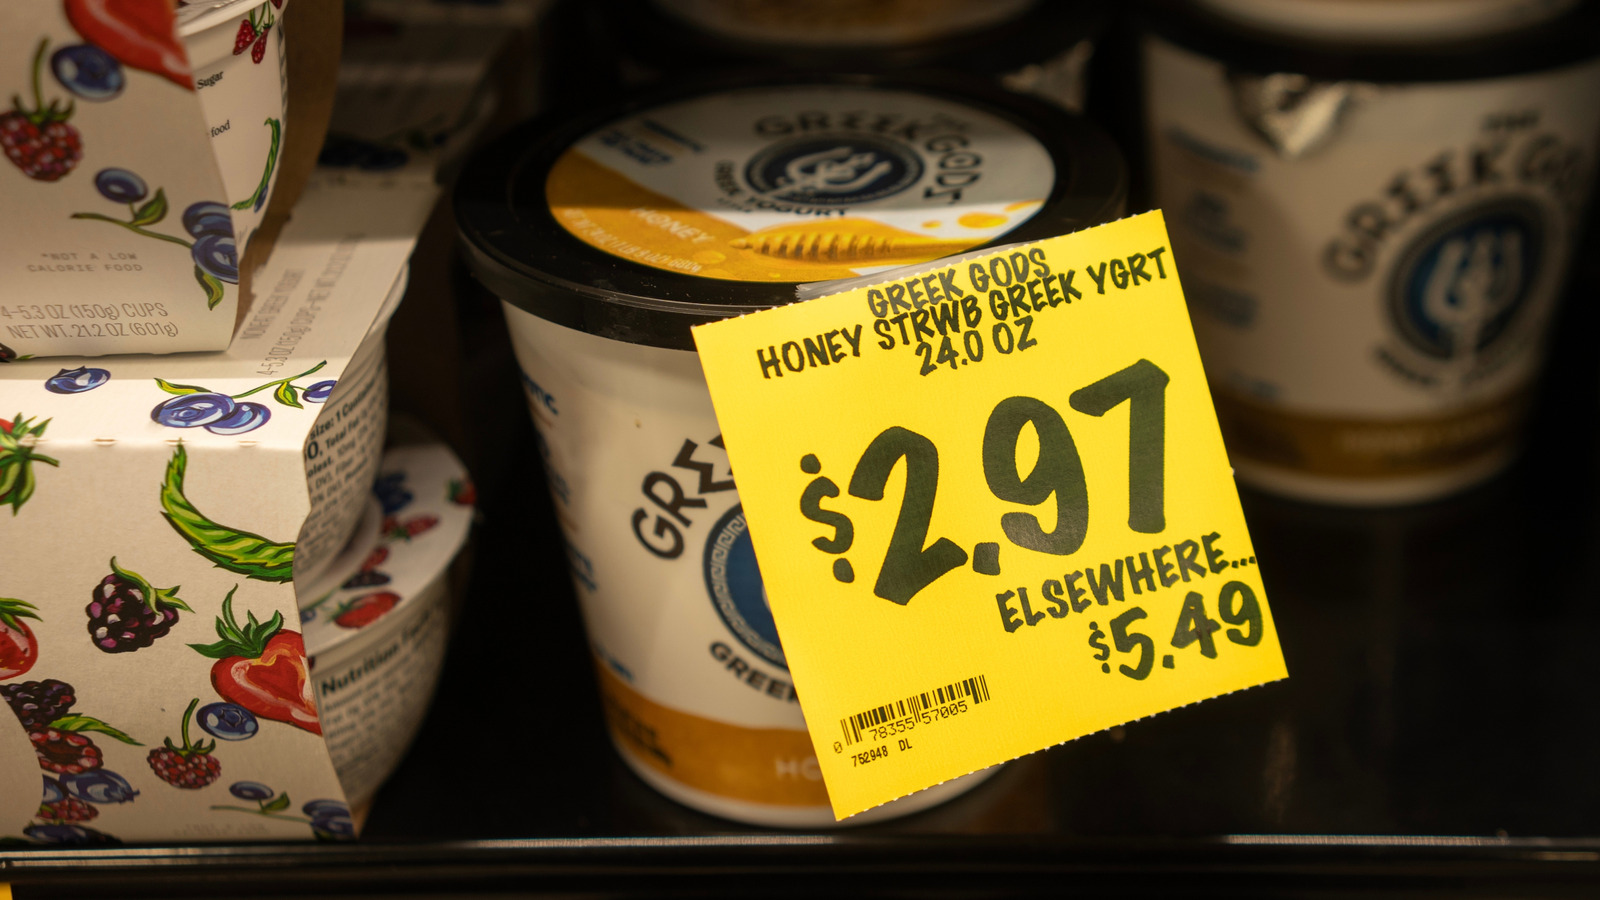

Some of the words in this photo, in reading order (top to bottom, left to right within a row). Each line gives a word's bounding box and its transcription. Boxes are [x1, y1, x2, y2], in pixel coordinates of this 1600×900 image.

[197, 70, 225, 90] Sugar
[211, 119, 231, 138] food
[26, 264, 95, 272] CALORIE
[105, 263, 143, 272] FOOD
[867, 268, 964, 319] GREEK
[969, 247, 1051, 294] GODS
[69, 303, 120, 321] (150g)
[122, 302, 169, 318] CUPS
[756, 324, 863, 379] HONEY
[873, 294, 983, 351] STRWB
[988, 269, 1083, 322] GREEK
[1085, 246, 1167, 295] YGRT
[6, 325, 40, 339] NET
[38, 323, 73, 339] WT.
[72, 323, 106, 338] 21.2
[105, 322, 130, 337] OZ
[129, 321, 179, 338] (601g)
[914, 329, 984, 377] 24.0
[992, 314, 1039, 355] OZ
[309, 417, 335, 440] size:
[304, 441, 324, 461] 0,
[800, 358, 1170, 606] $2.97
[995, 531, 1258, 634] ELSEWHERE...
[1088, 580, 1264, 681] $5.49
[321, 642, 400, 697] Nutrition
[868, 716, 916, 742] 78355
[921, 699, 968, 725] 57005
[850, 745, 889, 767] 752948
[898, 738, 913, 751] DL
